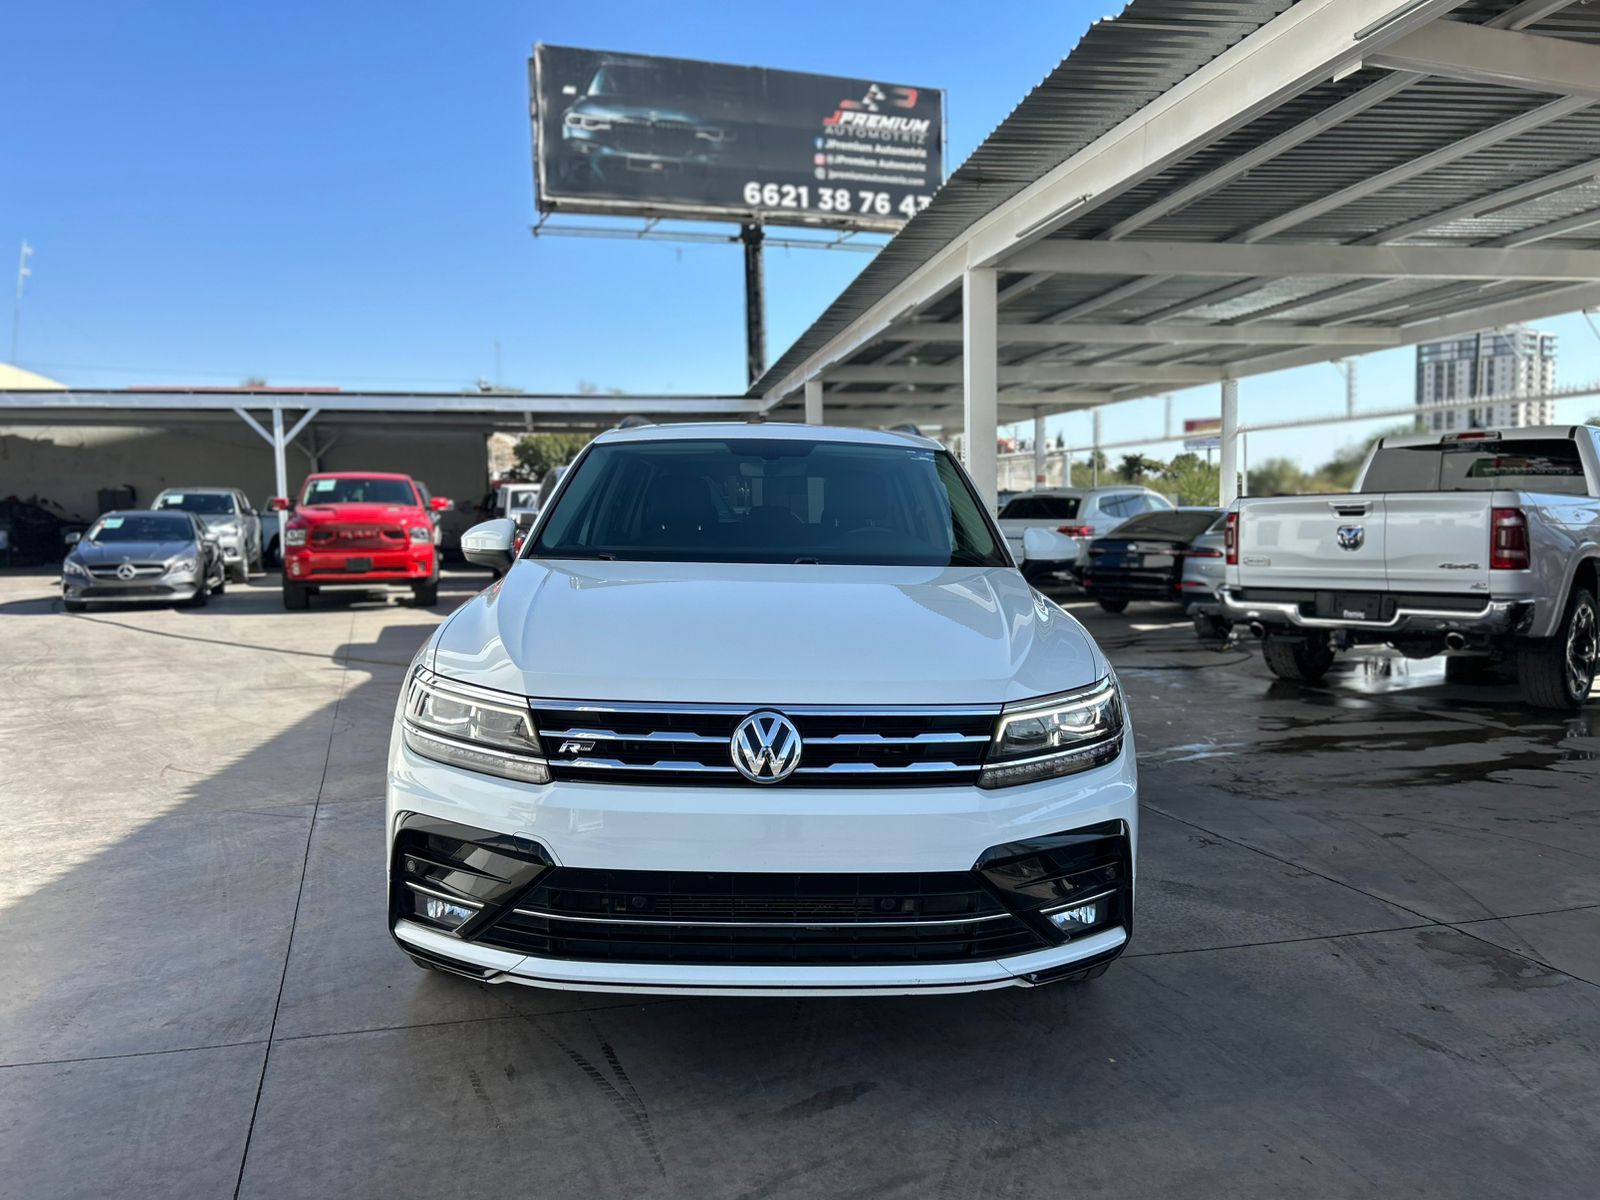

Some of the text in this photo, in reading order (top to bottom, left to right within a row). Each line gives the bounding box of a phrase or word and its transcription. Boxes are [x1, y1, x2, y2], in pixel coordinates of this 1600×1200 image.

[825, 124, 928, 144] AUTOMOTRIZ
[744, 182, 809, 208] 6621
[818, 187, 851, 211] 38
[858, 191, 891, 214] 76
